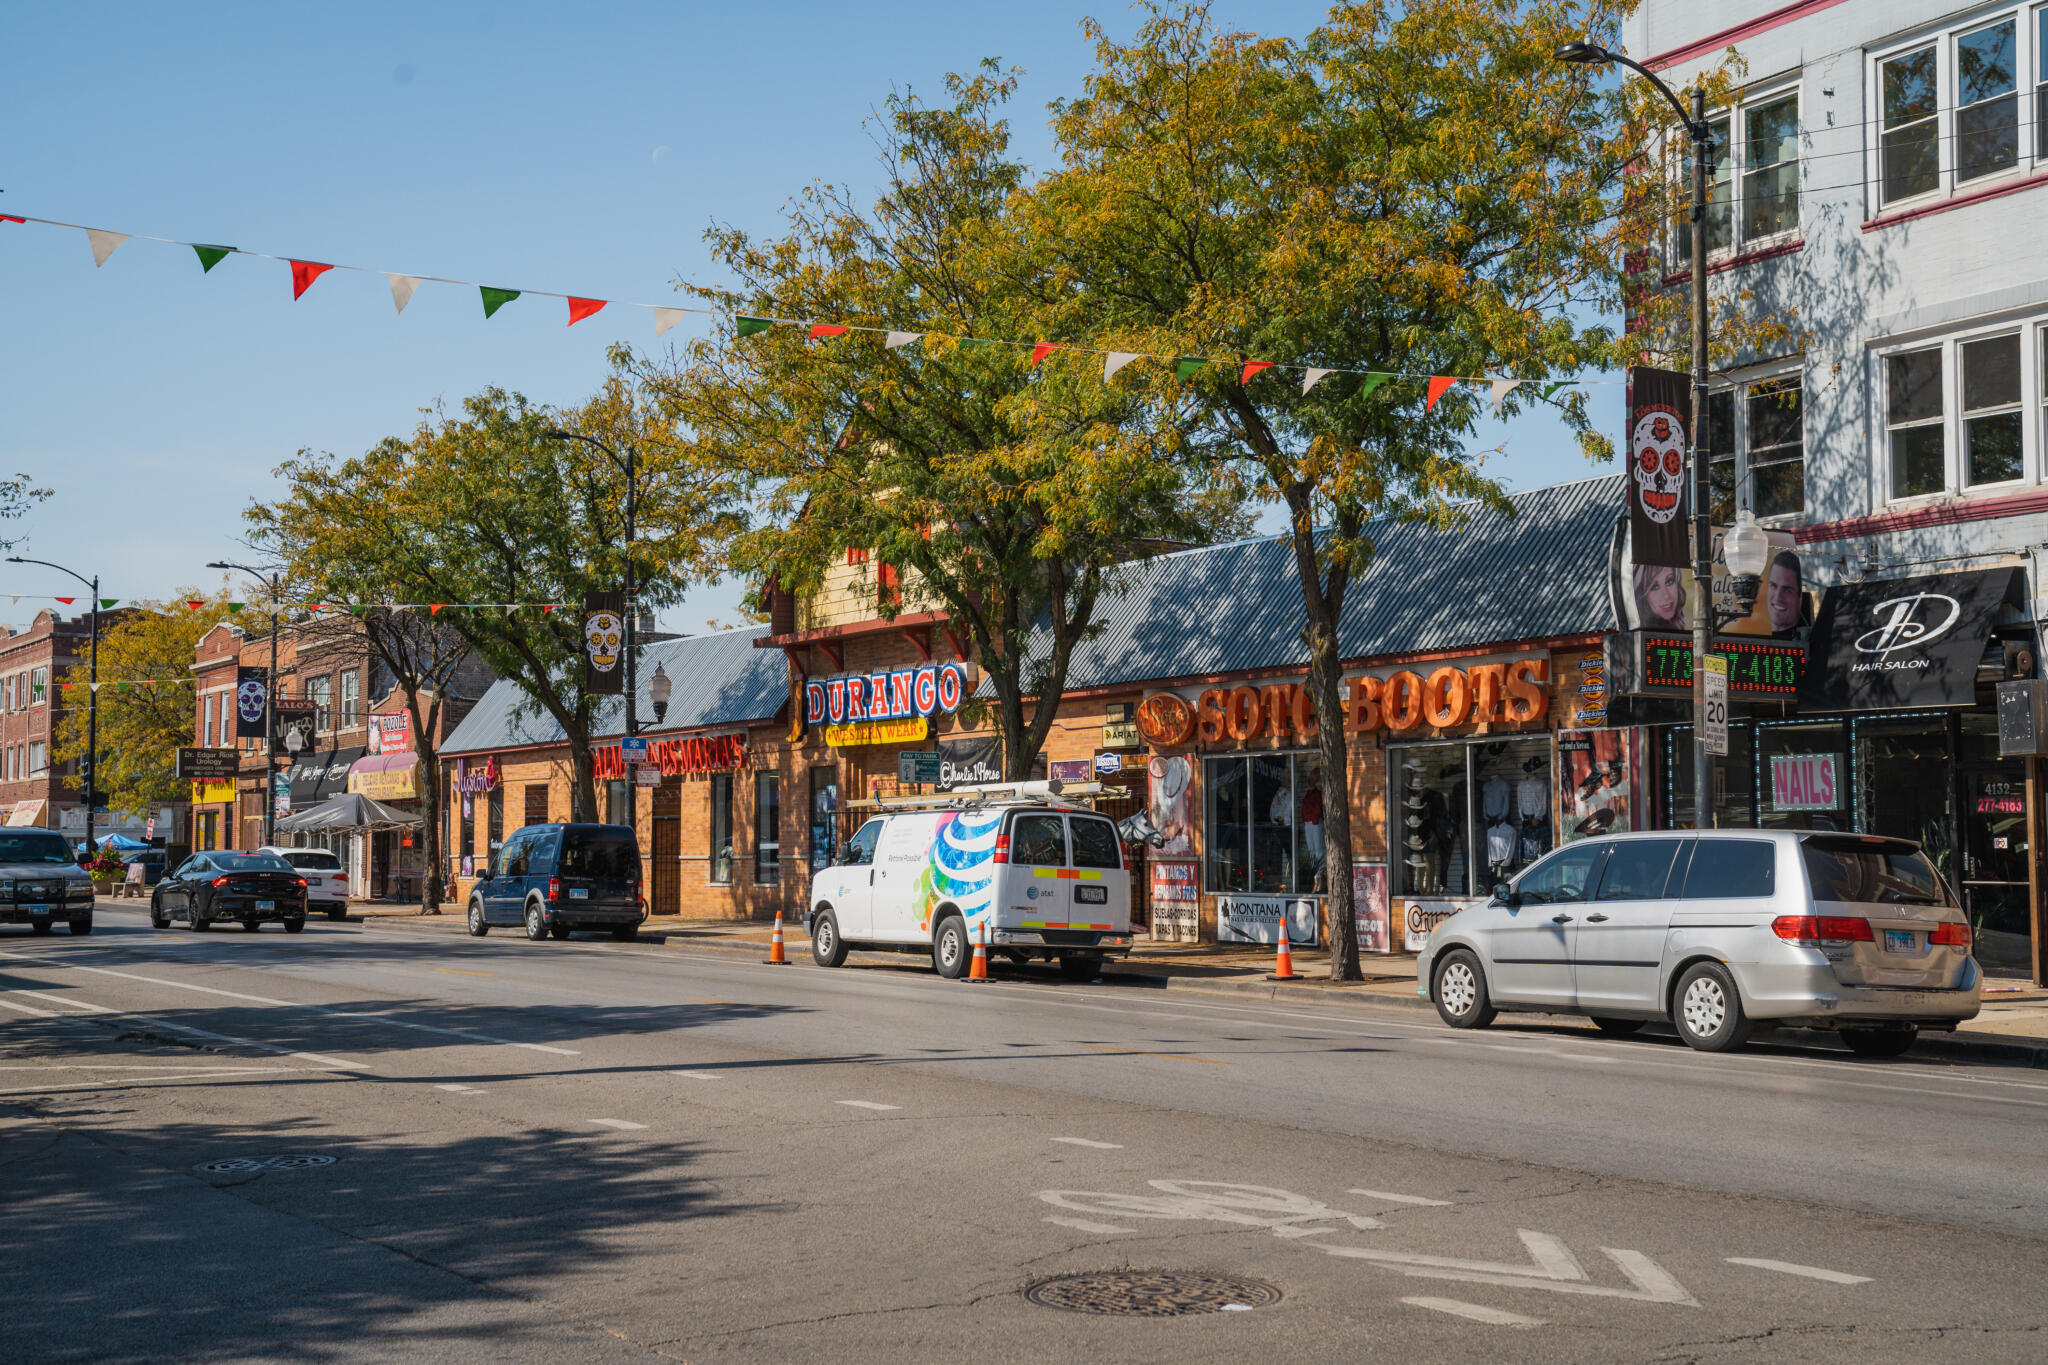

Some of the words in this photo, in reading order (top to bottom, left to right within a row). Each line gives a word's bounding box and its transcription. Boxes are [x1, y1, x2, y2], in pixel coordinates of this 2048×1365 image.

[1580, 659, 1603, 668] Dickie
[1657, 649, 1693, 679] 773
[1714, 652, 1795, 684] 7-4183
[1851, 663, 1882, 672] HAIR
[1884, 660, 1930, 670] SALON
[1706, 676, 1725, 688] SPEED
[806, 664, 962, 725] DURANGO
[1198, 682, 1320, 742] SOTO
[1345, 658, 1549, 731] BOOTS
[1708, 689, 1724, 699] LIMIT
[275, 701, 314, 709] LALO'S
[1142, 697, 1186, 737] Soto
[1579, 710, 1606, 718] Dickies
[1707, 701, 1725, 724] 20
[382, 714, 408, 732] POZOLE
[832, 725, 883, 743] WESTERN
[886, 723, 918, 738] WEAR
[1112, 730, 1137, 740] ARIAT
[680, 733, 743, 773] MARIA'S
[938, 761, 973, 788] Charlie
[978, 761, 1001, 781] Horse
[1774, 760, 1834, 804] NAILS
[1985, 783, 2010, 795] 4132
[1977, 797, 2022, 812] 277-4183
[1155, 864, 1189, 881] PINTAMOS
[1190, 865, 1195, 880] Y
[1231, 902, 1281, 916] MONTANA
[1231, 916, 1280, 924] SILVERSMITH
[1155, 923, 1171, 935] TAPAS
[1356, 934, 1373, 945] ATS
